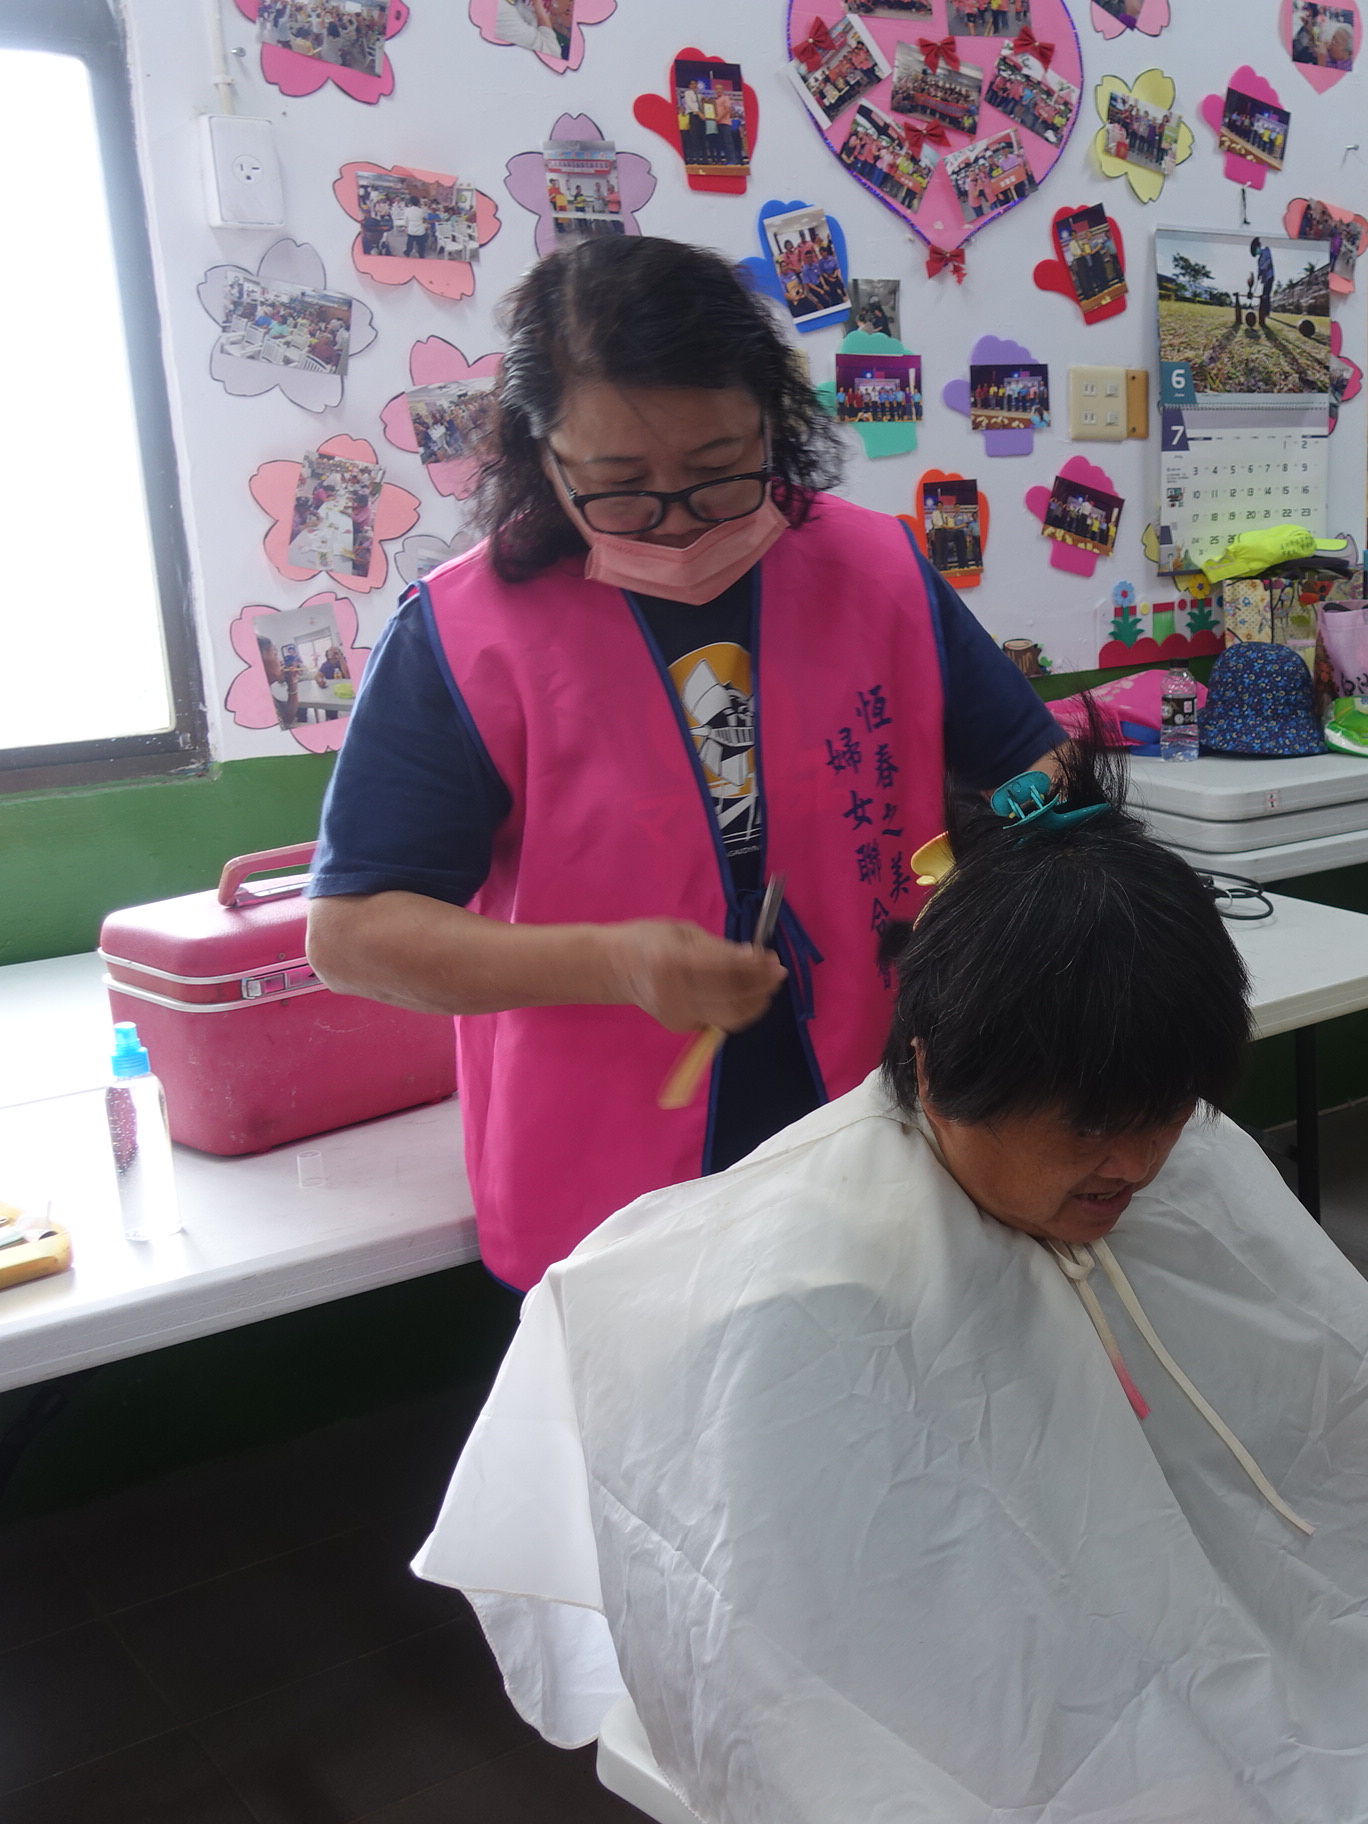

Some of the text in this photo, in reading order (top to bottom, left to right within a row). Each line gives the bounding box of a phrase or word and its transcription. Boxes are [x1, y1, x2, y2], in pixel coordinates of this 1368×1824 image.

[1171, 369, 1186, 389] 6
[1171, 425, 1185, 446] 7
[1301, 440, 1308, 449] 2
[1193, 466, 1199, 476] 3
[1212, 466, 1218, 474] 4
[1230, 465, 1236, 474] 5
[1248, 464, 1254, 474] 6
[1265, 463, 1271, 472] 7
[1282, 463, 1288, 472] 8
[1302, 463, 1308, 472] 9
[1193, 485, 1310, 499] 10 11 12 13 14 15 16
[1192, 508, 1311, 523] 17 18 19 20 21 22 23
[1210, 535, 1219, 545] 25
